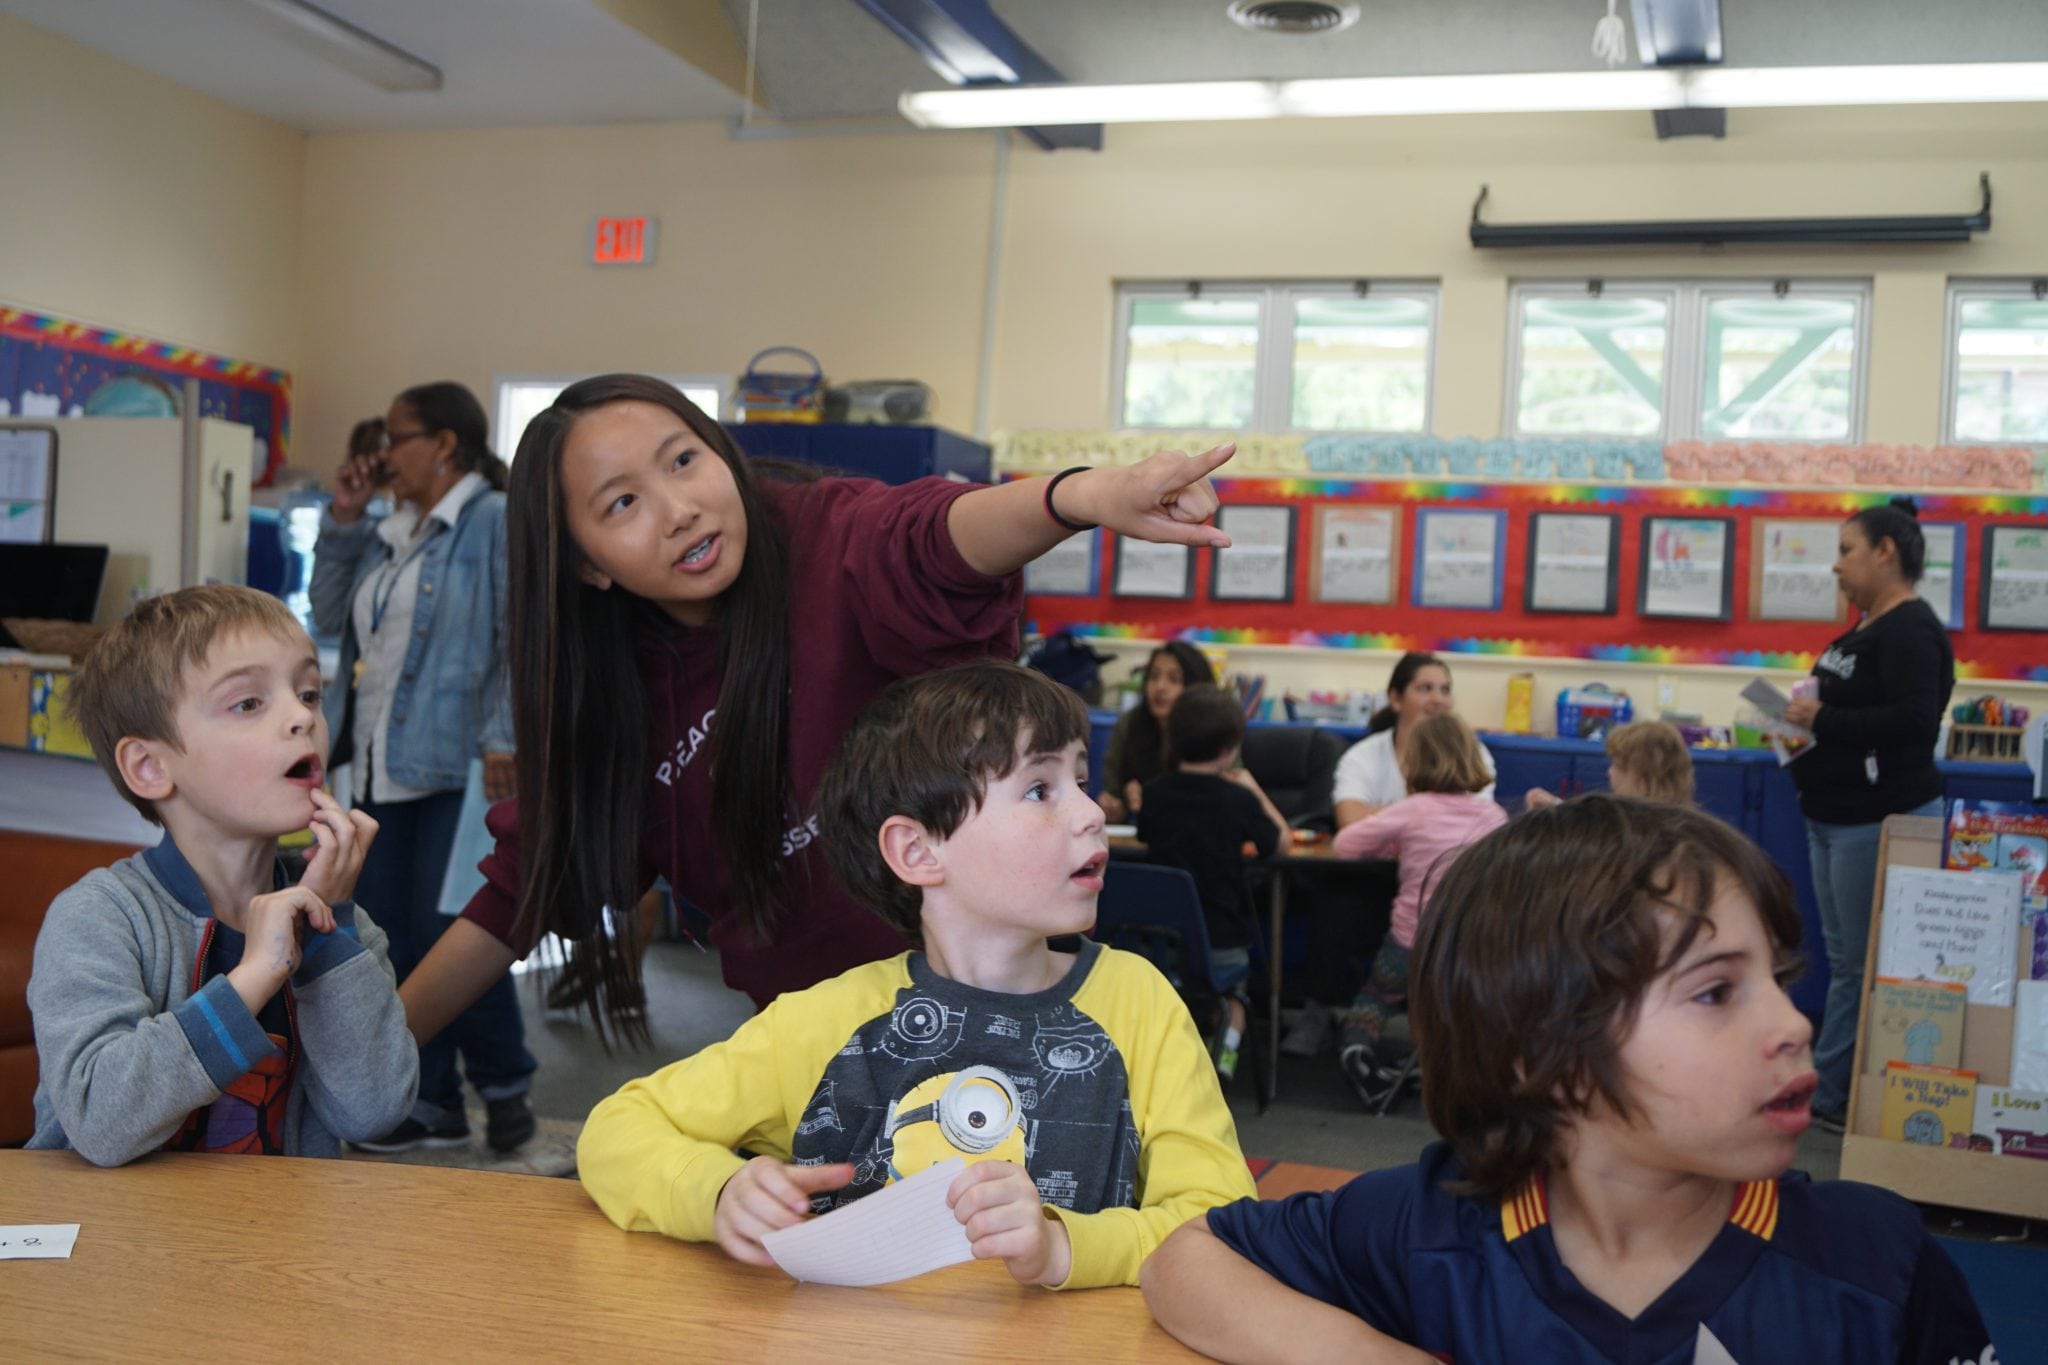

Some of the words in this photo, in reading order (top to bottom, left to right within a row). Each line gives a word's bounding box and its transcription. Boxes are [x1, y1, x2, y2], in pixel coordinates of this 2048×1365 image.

[594, 215, 649, 263] EXIT
[654, 708, 717, 786] PEAC
[1991, 1092, 1999, 1107] I
[2003, 1092, 2041, 1111] Love
